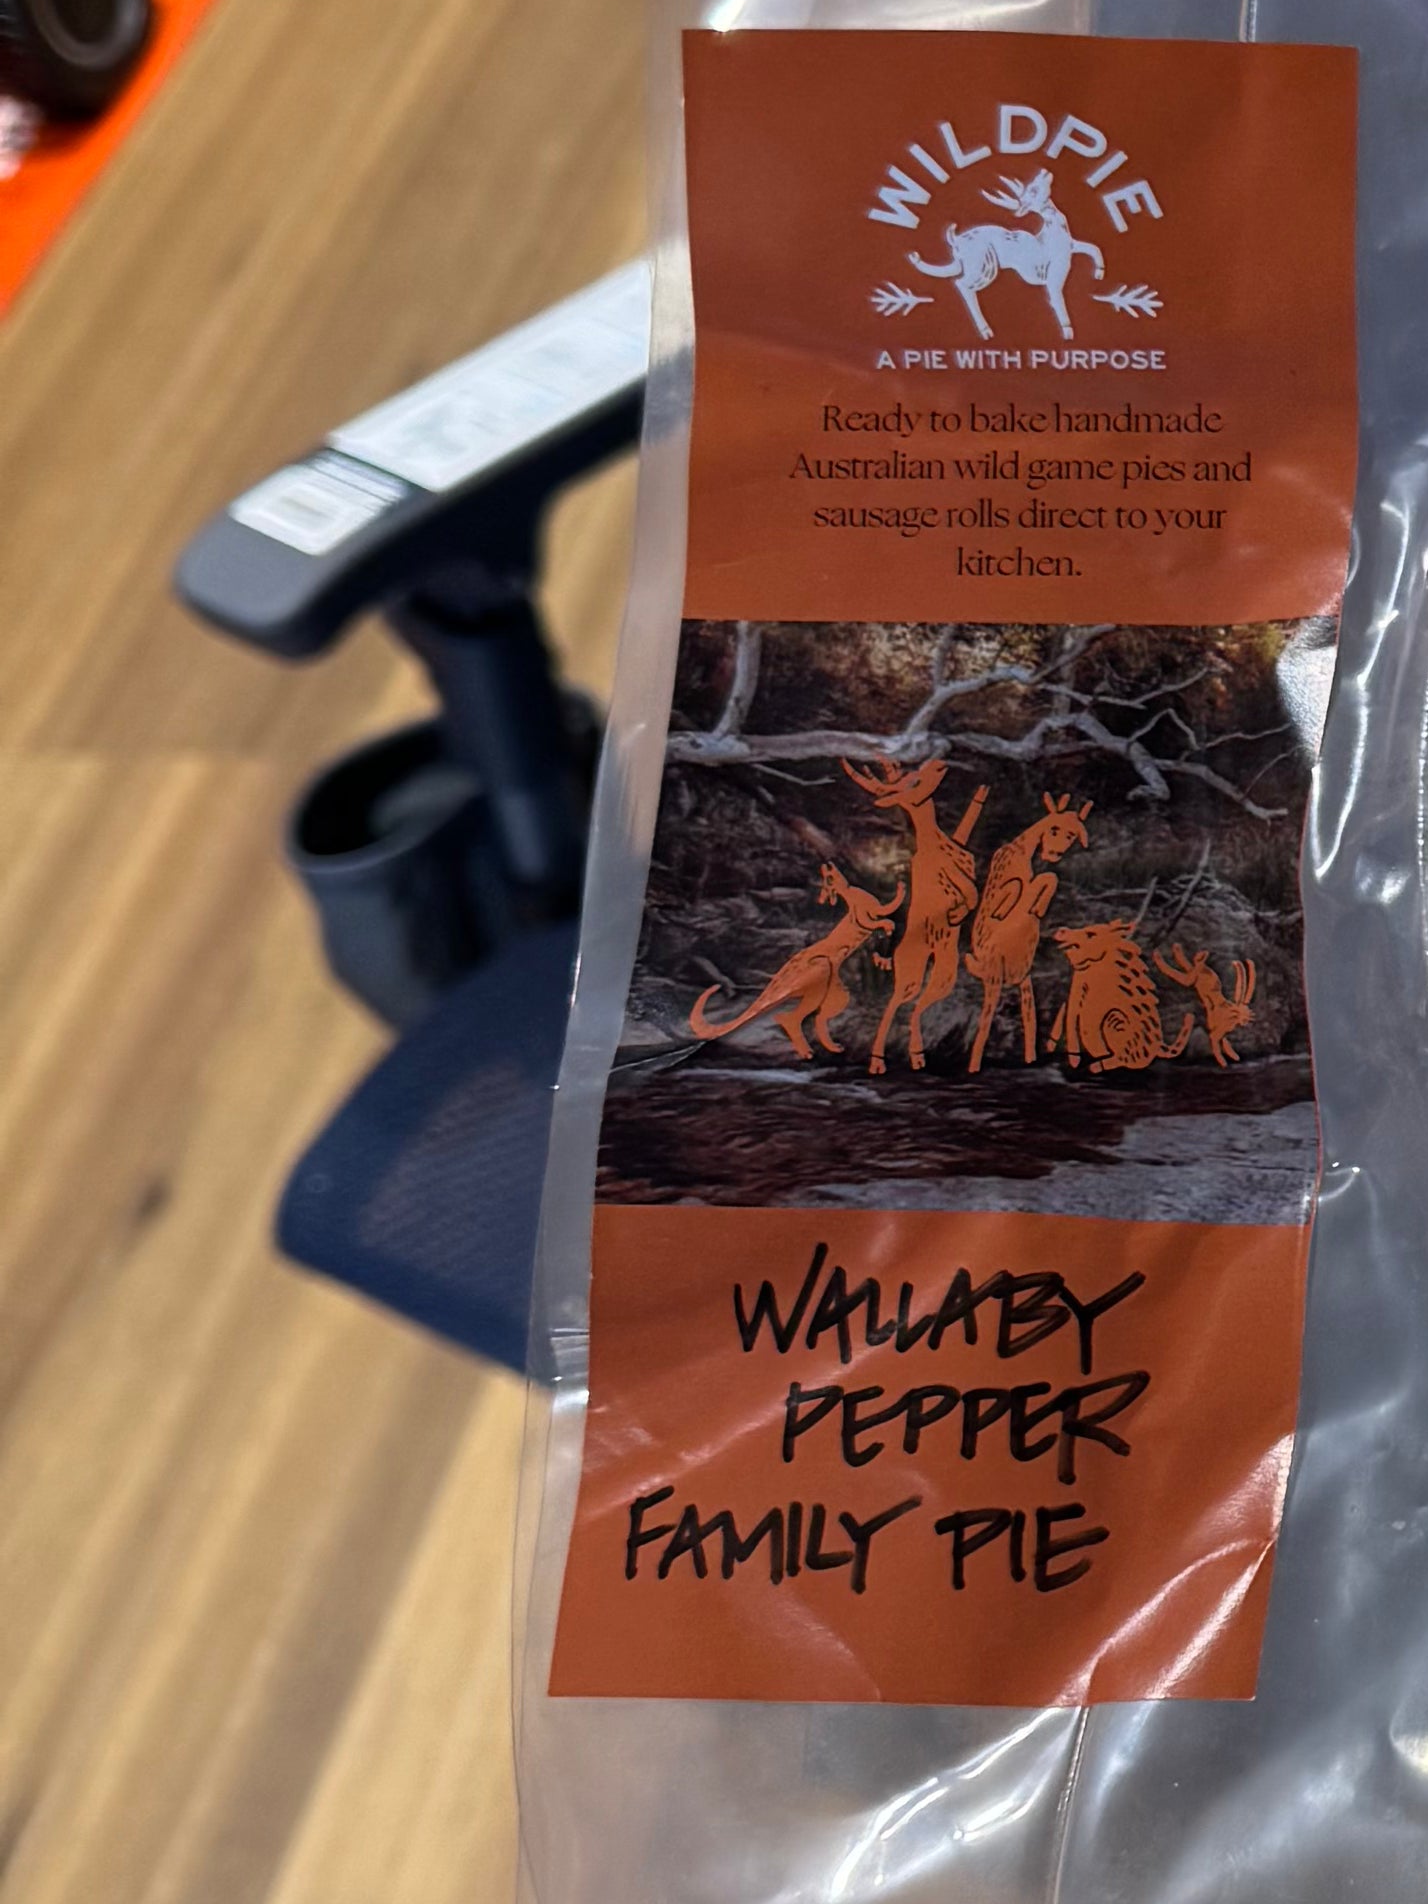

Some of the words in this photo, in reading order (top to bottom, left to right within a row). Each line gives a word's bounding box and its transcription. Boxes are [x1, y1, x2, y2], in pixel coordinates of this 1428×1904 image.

[868, 104, 1164, 234] WILDPIE
[876, 350, 897, 370] A
[904, 350, 947, 370] PIE
[956, 350, 1022, 370] WITH
[1031, 350, 1167, 370] PURPOSE
[821, 402, 922, 438] Ready
[929, 409, 961, 433] to
[969, 402, 1048, 433] bake
[1054, 404, 1223, 434] handmade
[790, 450, 946, 481] Australian
[953, 452, 1021, 483] wild
[1027, 457, 1116, 489] game
[1123, 455, 1187, 487] pies
[1193, 453, 1252, 483] and
[813, 502, 937, 535] sausage
[946, 497, 1009, 530] rolls
[1018, 497, 1107, 530] direct
[1116, 506, 1147, 530] to
[1153, 504, 1227, 536] your
[956, 548, 1083, 577] kitchen.
[733, 1242, 1145, 1374] WALLABY
[783, 1370, 1150, 1484] PEPPER
[624, 1486, 922, 1594] FAMILY
[935, 1503, 1110, 1592] PIE
